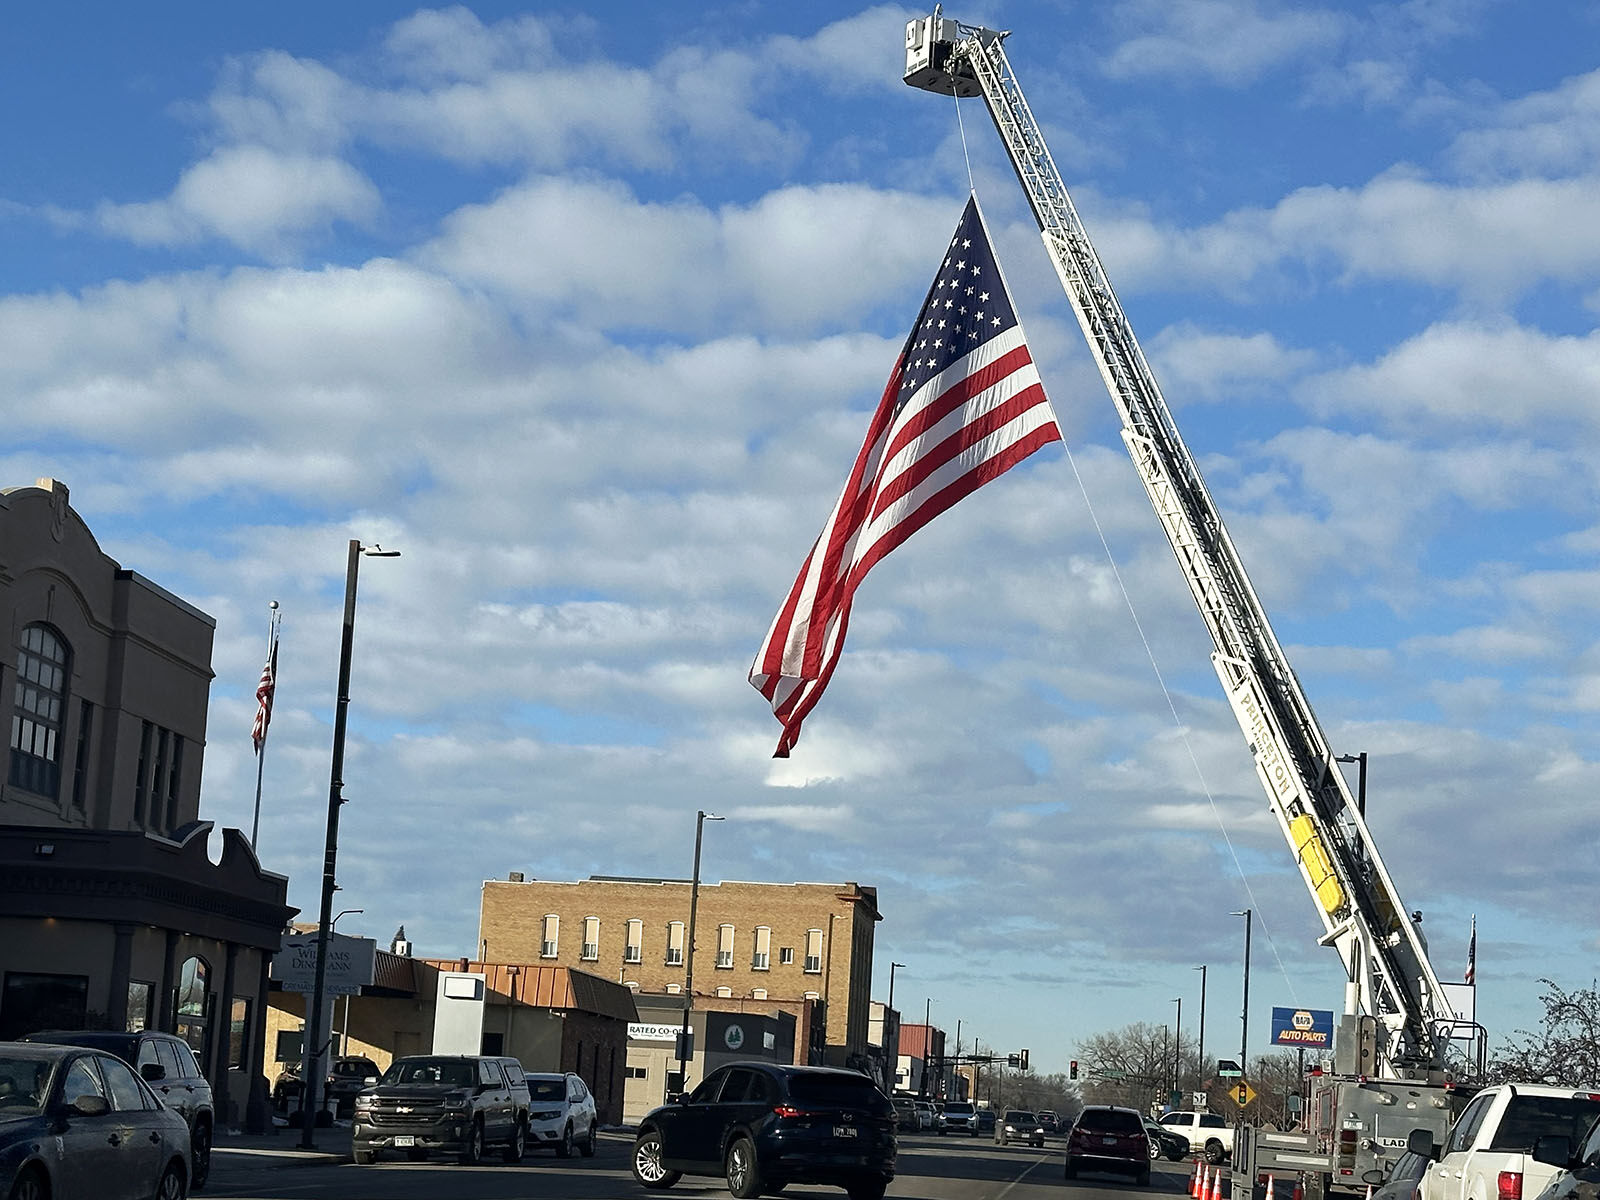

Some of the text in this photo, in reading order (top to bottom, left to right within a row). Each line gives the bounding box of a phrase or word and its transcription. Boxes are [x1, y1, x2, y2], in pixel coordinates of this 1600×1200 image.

[1240, 692, 1290, 796] PRINCETON
[1295, 1016, 1311, 1025] NAPA
[629, 1026, 656, 1034] RATED
[1278, 1030, 1327, 1042] AUTO PARTS
[1383, 1138, 1409, 1147] LAD
